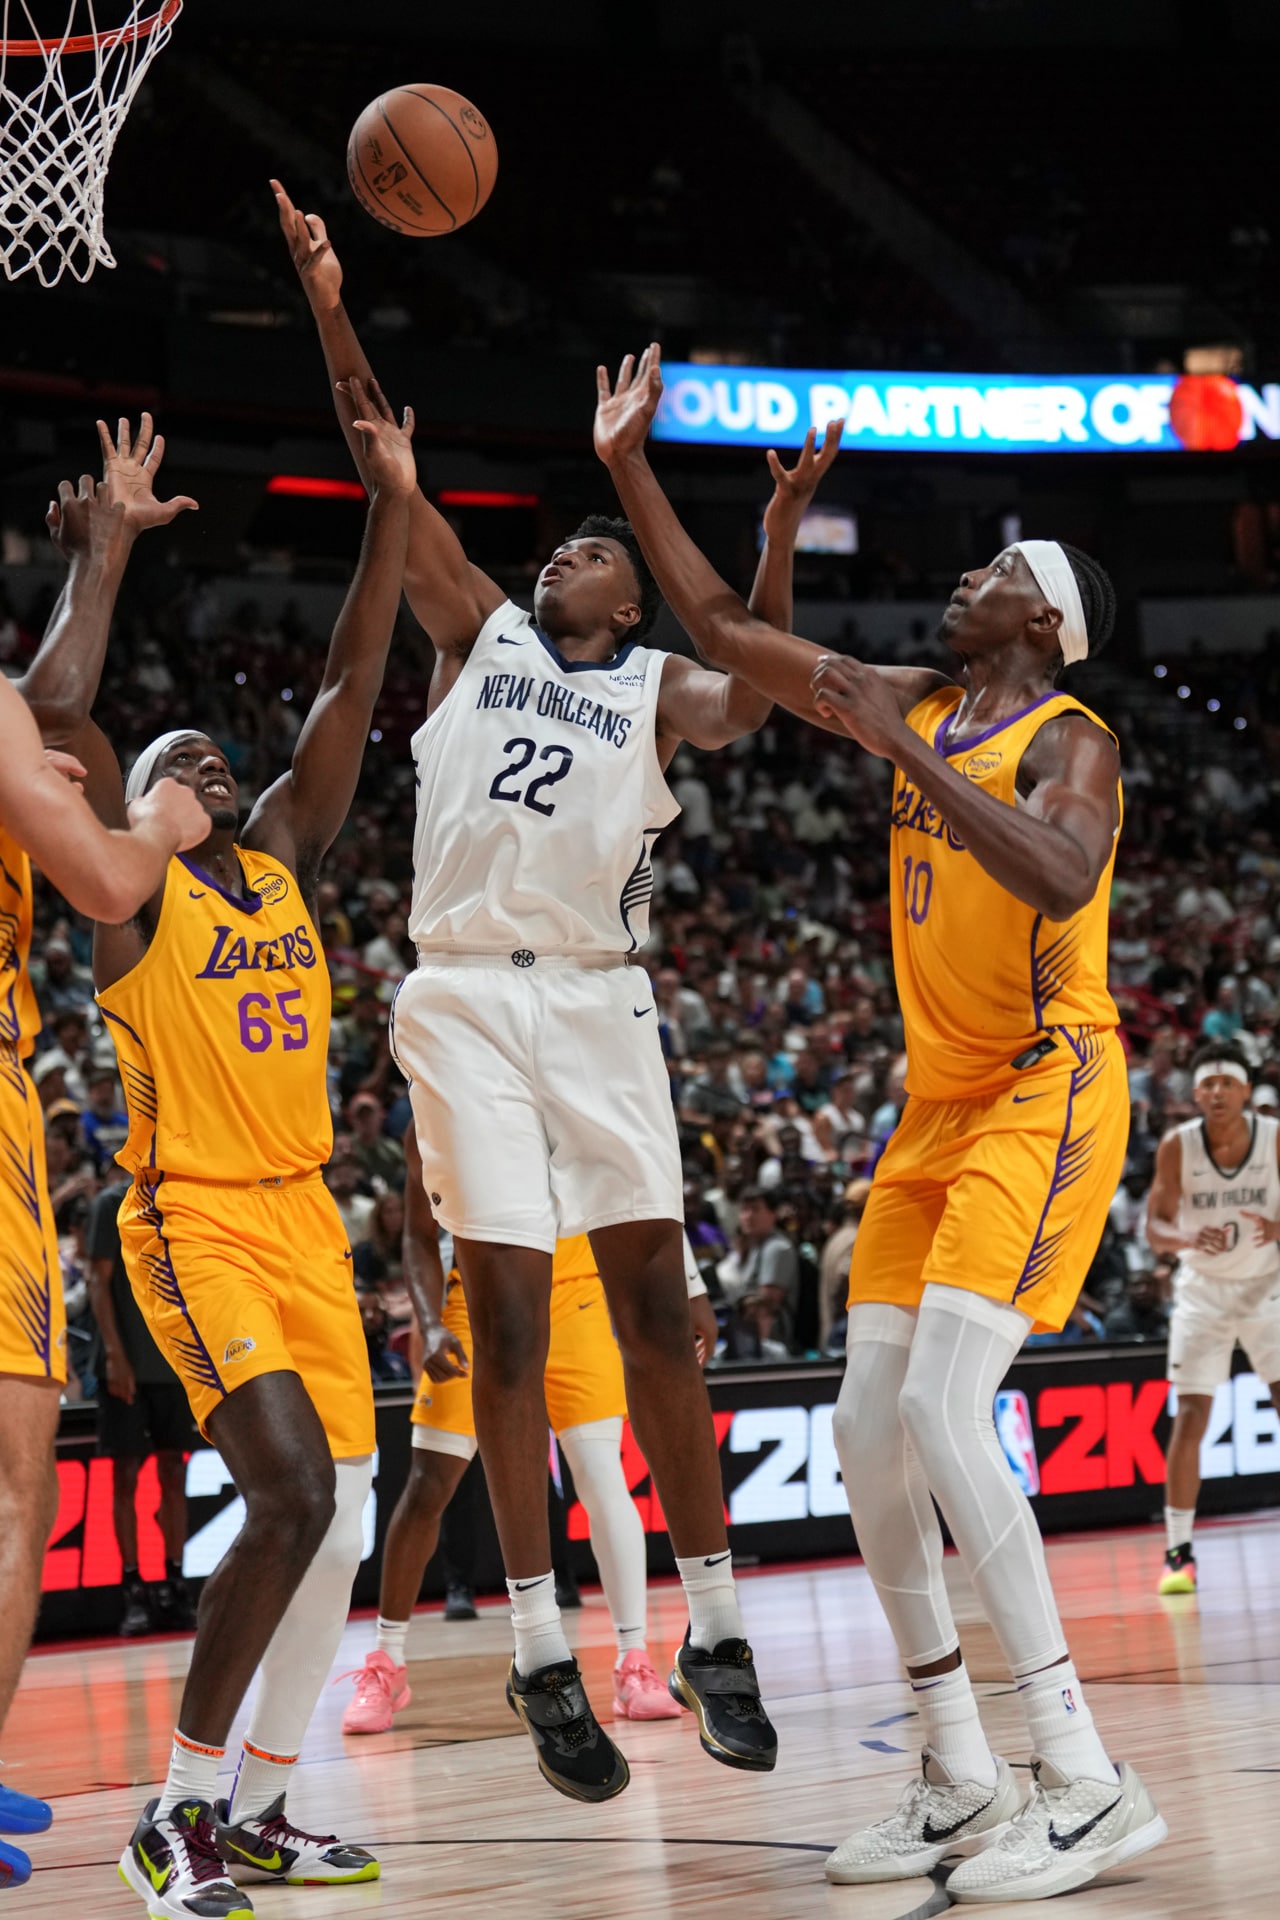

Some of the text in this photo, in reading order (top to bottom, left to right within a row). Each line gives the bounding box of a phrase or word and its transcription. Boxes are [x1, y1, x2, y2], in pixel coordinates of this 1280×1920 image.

[657, 379, 798, 433] OUD
[809, 384, 1089, 442] PARTNER
[1090, 383, 1170, 445] OF
[476, 674, 632, 749] NEW ORLEANS
[489, 737, 574, 817] 22
[903, 855, 934, 926] 10
[195, 925, 317, 979] LAKERS
[237, 988, 309, 1054] 65
